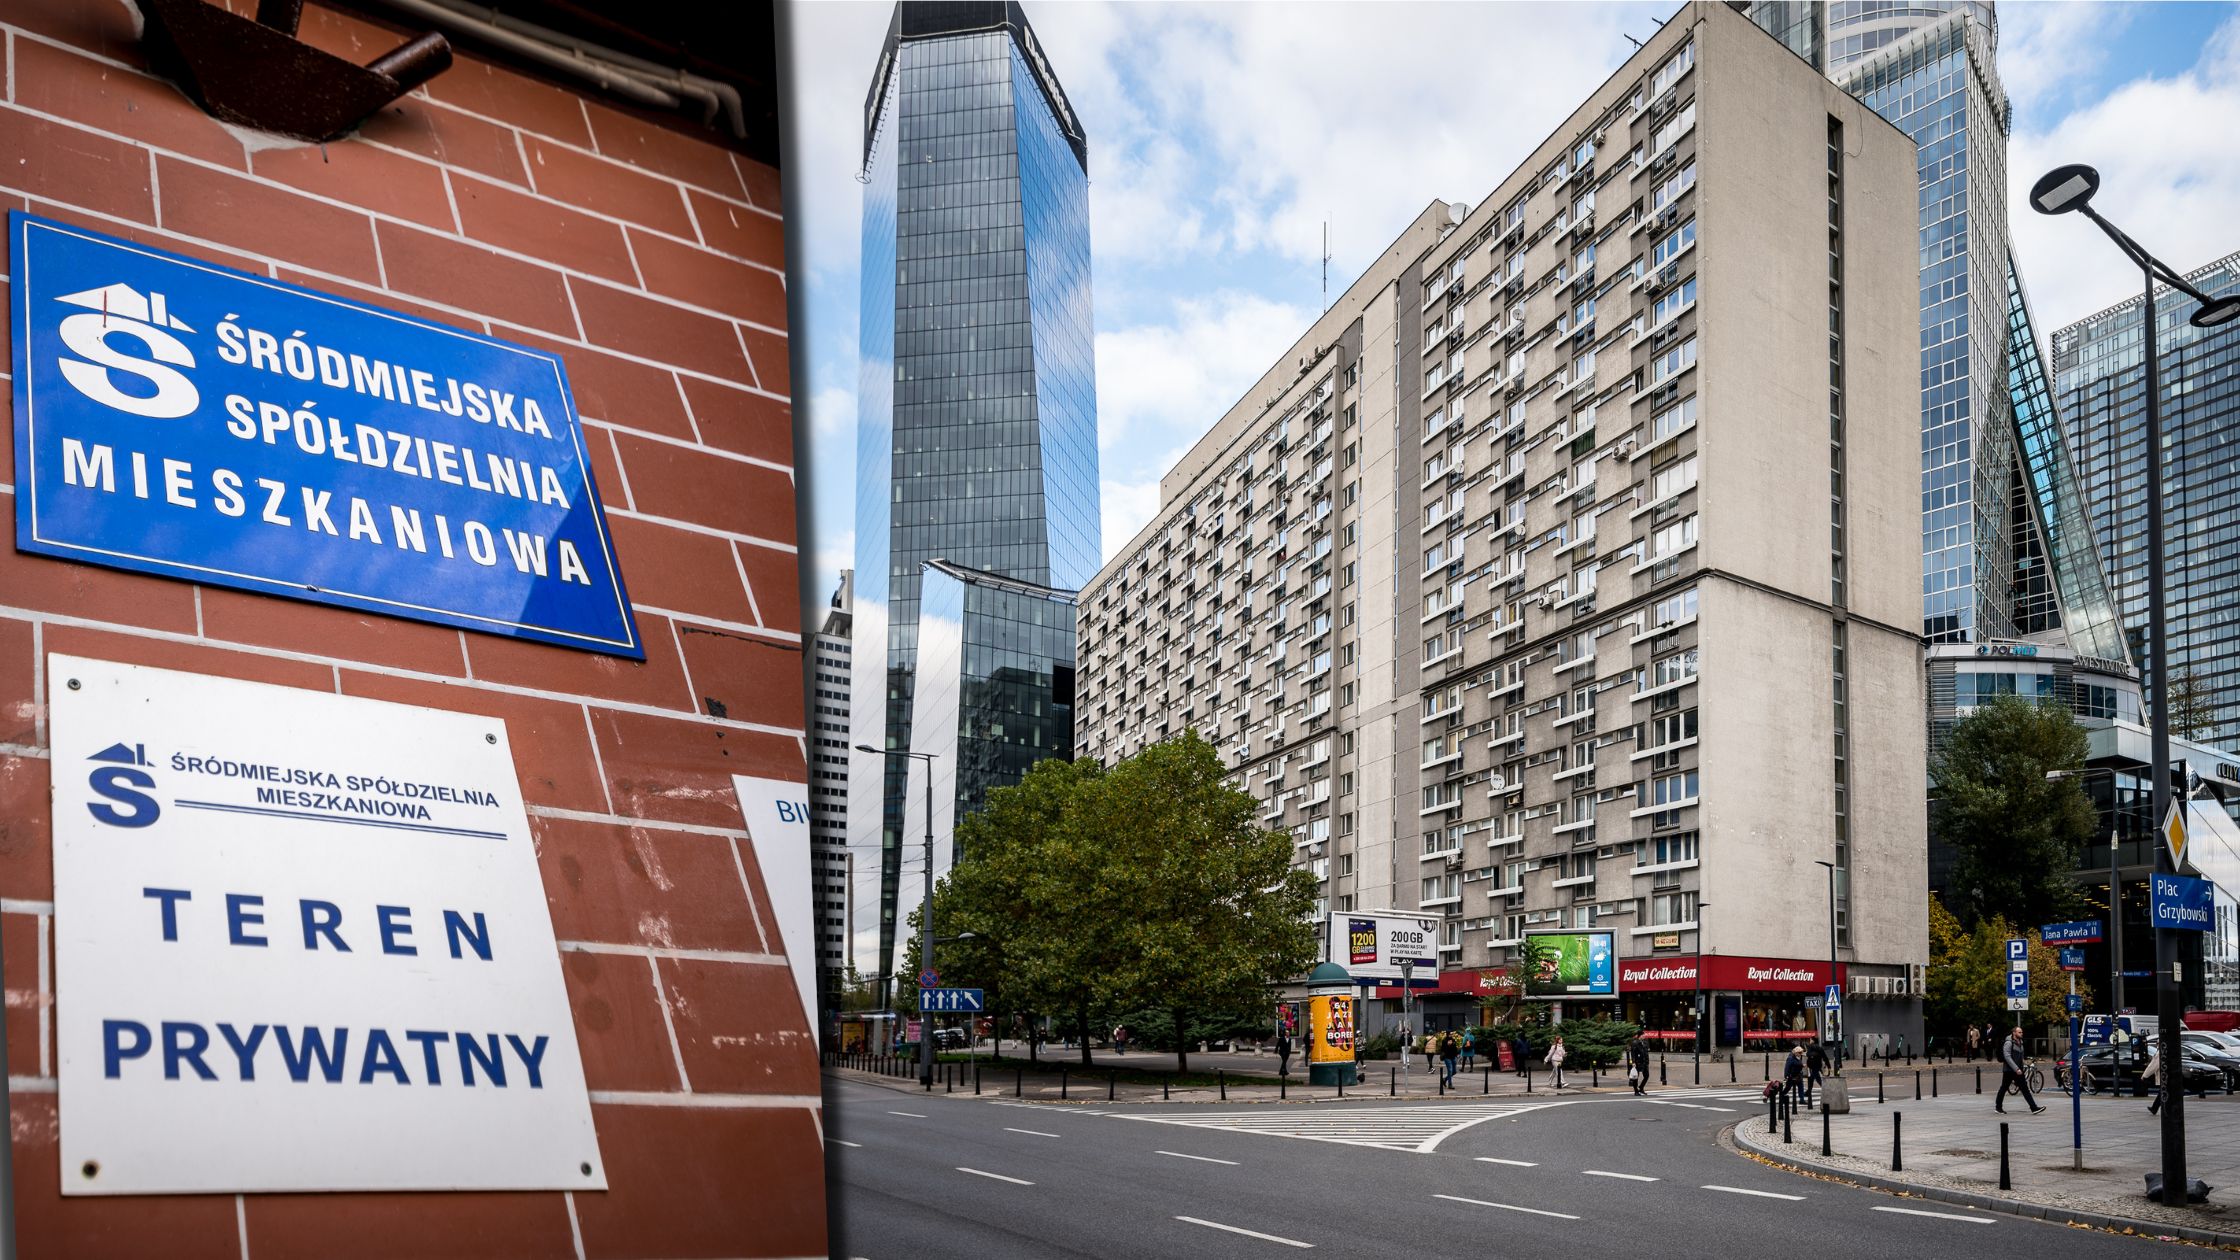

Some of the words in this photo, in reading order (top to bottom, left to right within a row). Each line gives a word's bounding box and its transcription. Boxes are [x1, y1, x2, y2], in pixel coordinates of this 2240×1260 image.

[217, 313, 553, 439] ŚRÓDMIEJSKA
[225, 395, 571, 510] SPÓŁDZIELNIA
[63, 438, 591, 586] MIESZKANIOWA
[171, 753, 341, 790] ŚRÓDMIEJSKA
[347, 774, 499, 808] SPÓŁDZIELNIA
[257, 787, 432, 821] MIESZKANIOWA
[2157, 880, 2179, 897] Plac
[2158, 903, 2208, 924] Grzybowski
[143, 887, 493, 961] TEREN
[2045, 930, 2061, 940] Jana
[2063, 928, 2088, 938] Pawła
[2091, 927, 2097, 936] II
[1351, 932, 1375, 946] 1200
[1391, 930, 1409, 943] 200
[1410, 931, 1424, 944] GB
[1352, 946, 1360, 954] GB
[1623, 968, 1648, 983] Royal
[1649, 966, 1697, 980] Collection
[1748, 967, 1772, 982] Royal
[1773, 967, 1814, 982] Collection
[1327, 1031, 1353, 1039] BOREE
[102, 1019, 550, 1089] PRYWATNY
